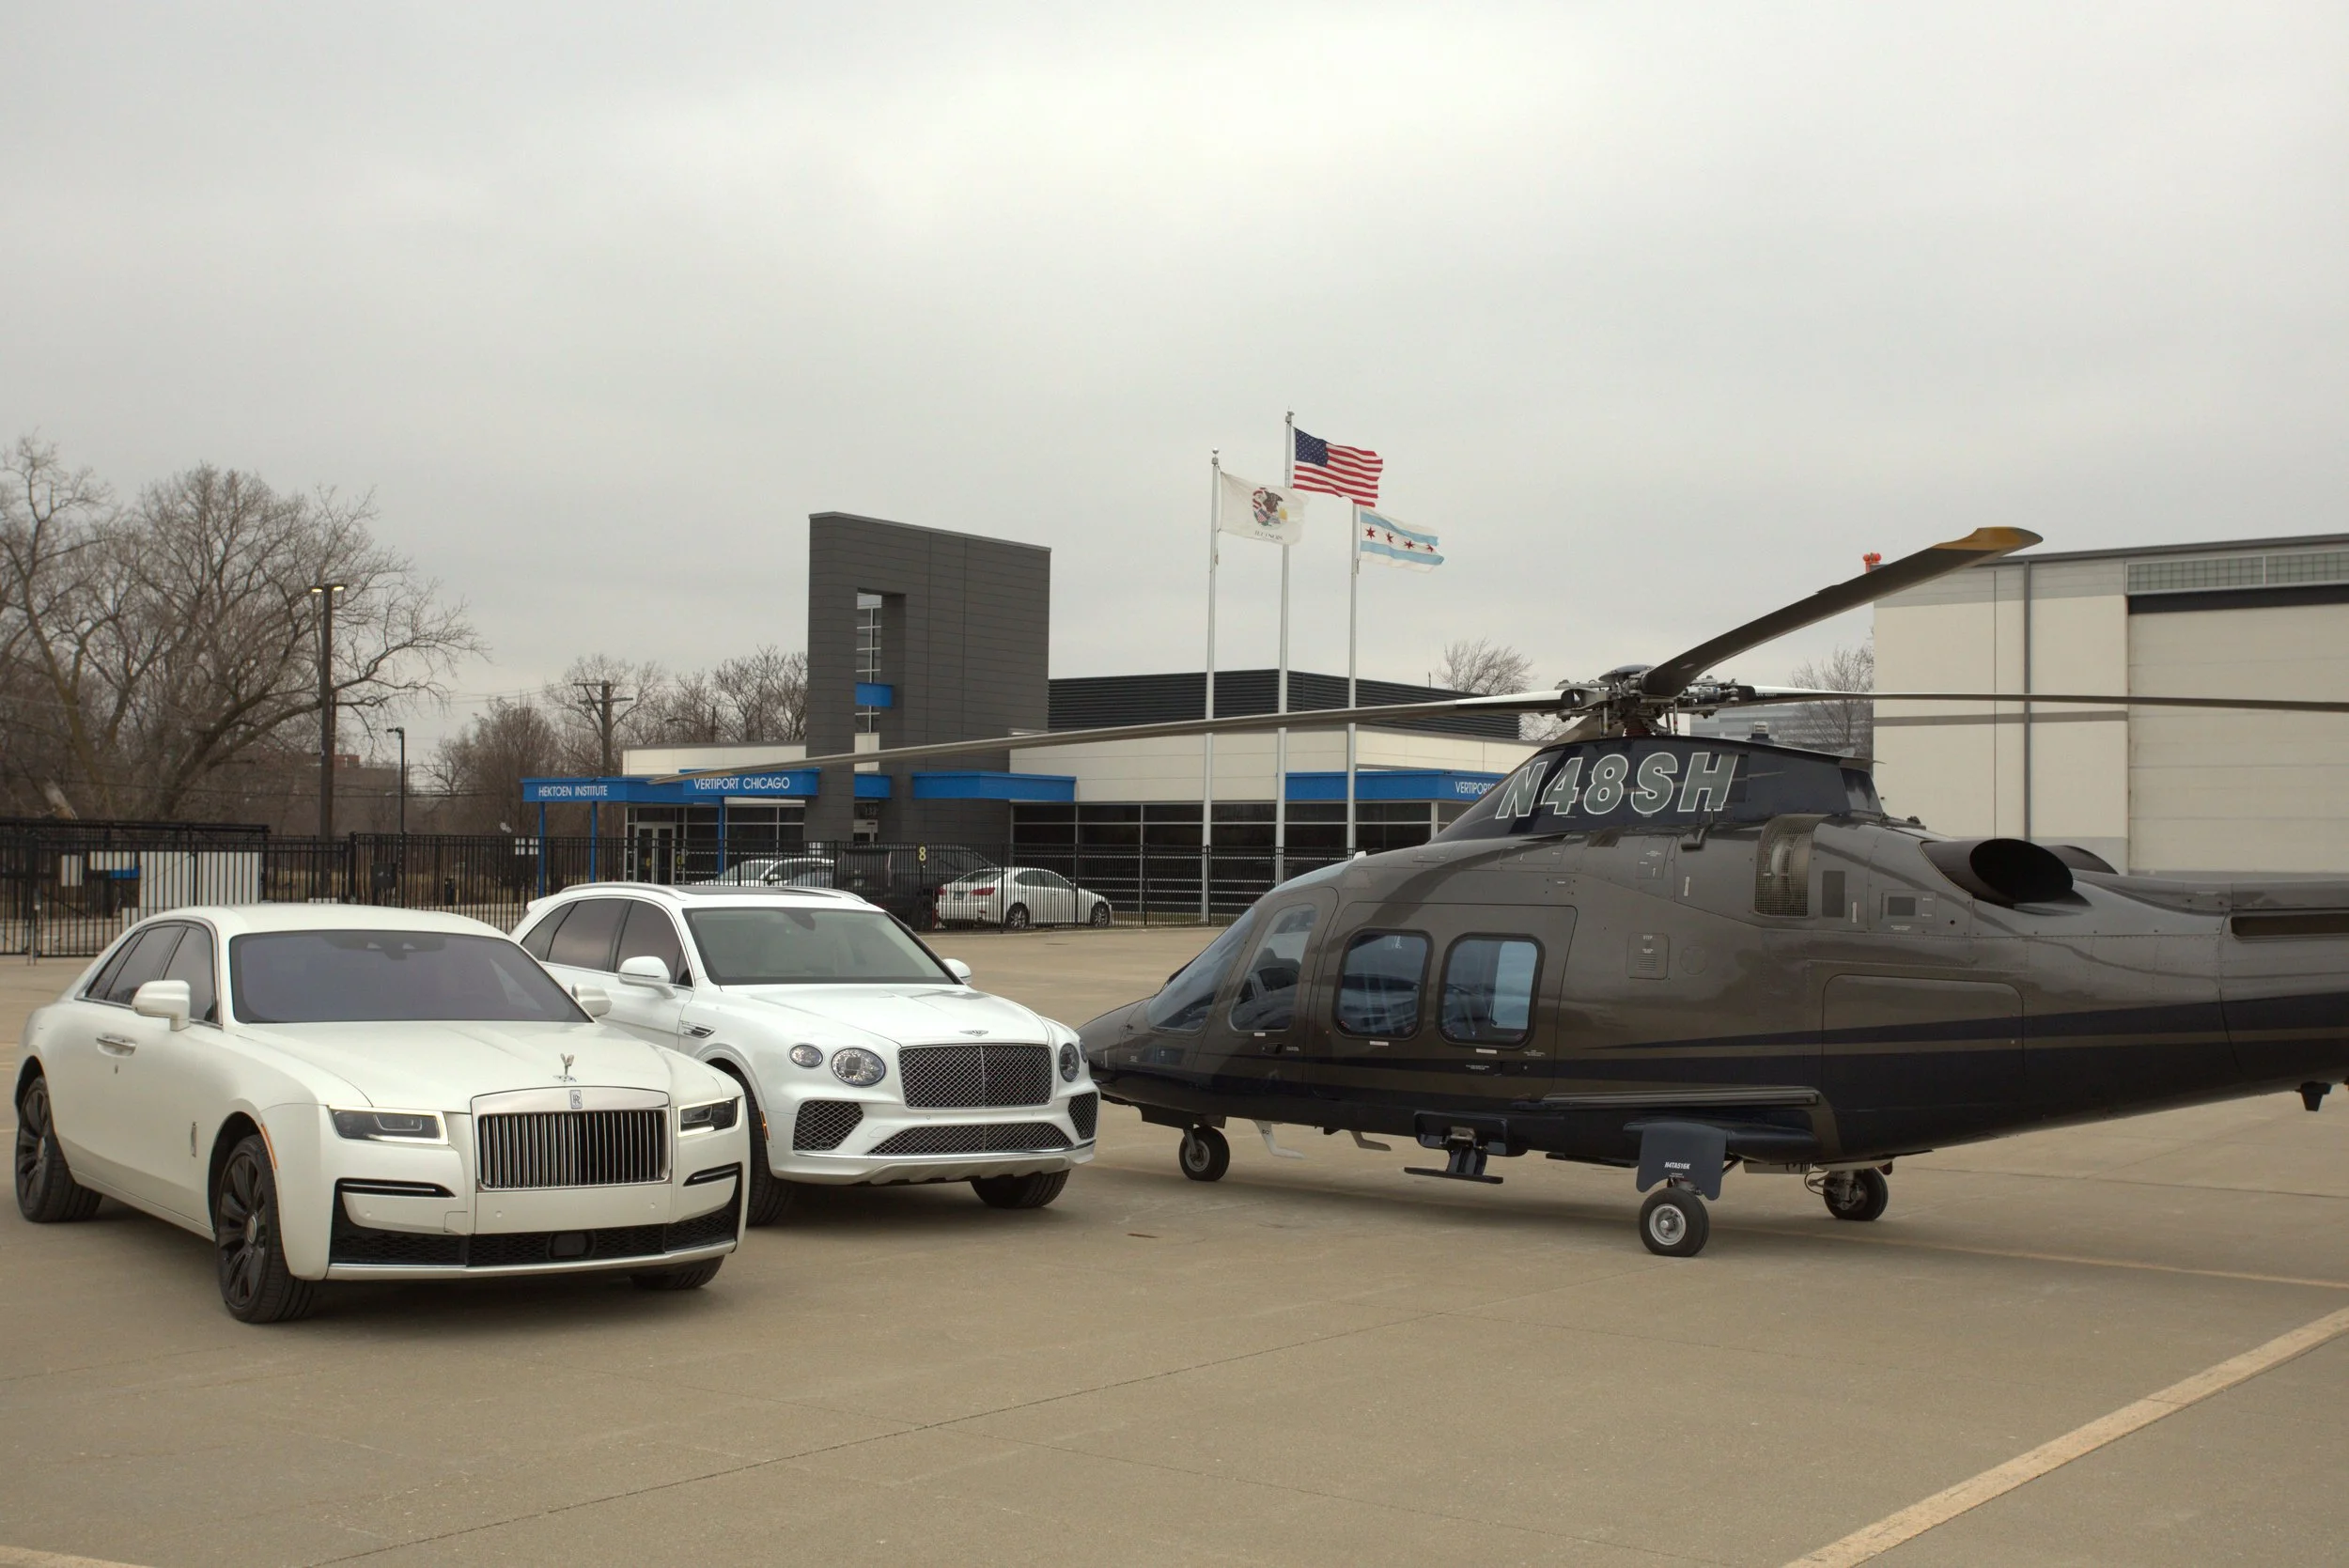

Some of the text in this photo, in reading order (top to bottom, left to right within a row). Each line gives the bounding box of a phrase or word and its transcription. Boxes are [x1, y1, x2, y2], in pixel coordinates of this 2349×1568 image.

[538, 784, 608, 797] HEKTOEN INSTITUTE
[694, 777, 790, 790] VERTIPORT CHICAGO
[1495, 752, 1737, 819] N48SH
[919, 846, 926, 861] 8
